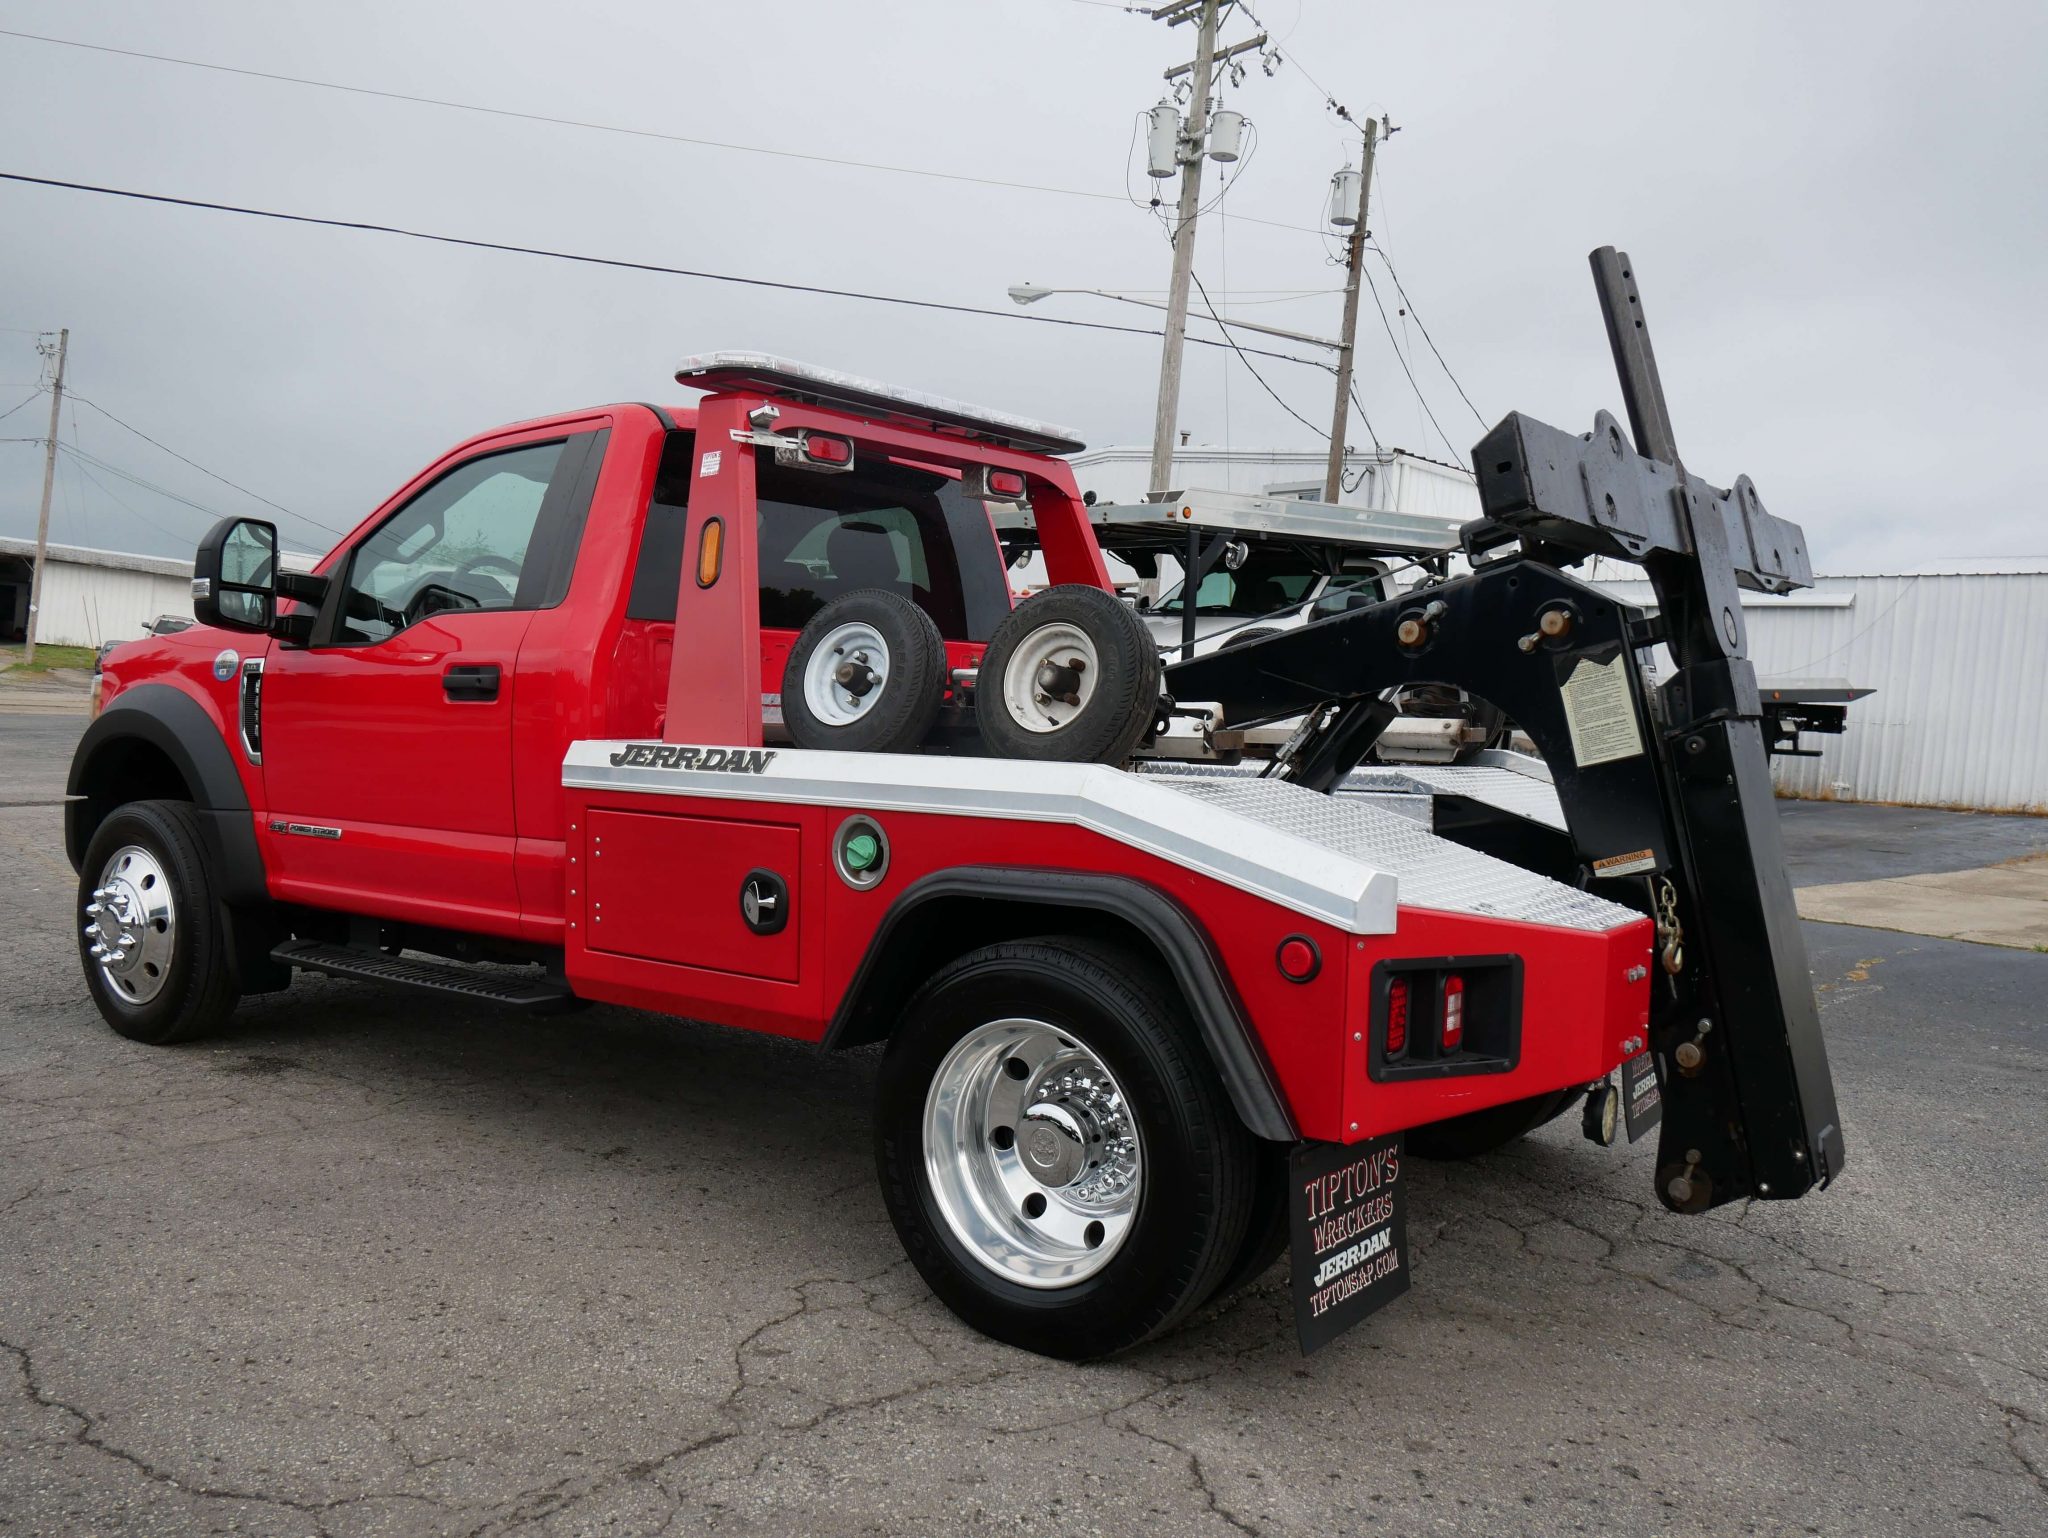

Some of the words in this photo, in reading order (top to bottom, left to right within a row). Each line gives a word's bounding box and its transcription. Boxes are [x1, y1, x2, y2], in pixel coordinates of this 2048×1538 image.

[290, 825, 312, 834] POWER
[313, 827, 339, 837] STROKE
[1605, 851, 1646, 866] WARNING
[1304, 1144, 1399, 1221] TIPTON'S
[1313, 1191, 1394, 1255] WRECKERS
